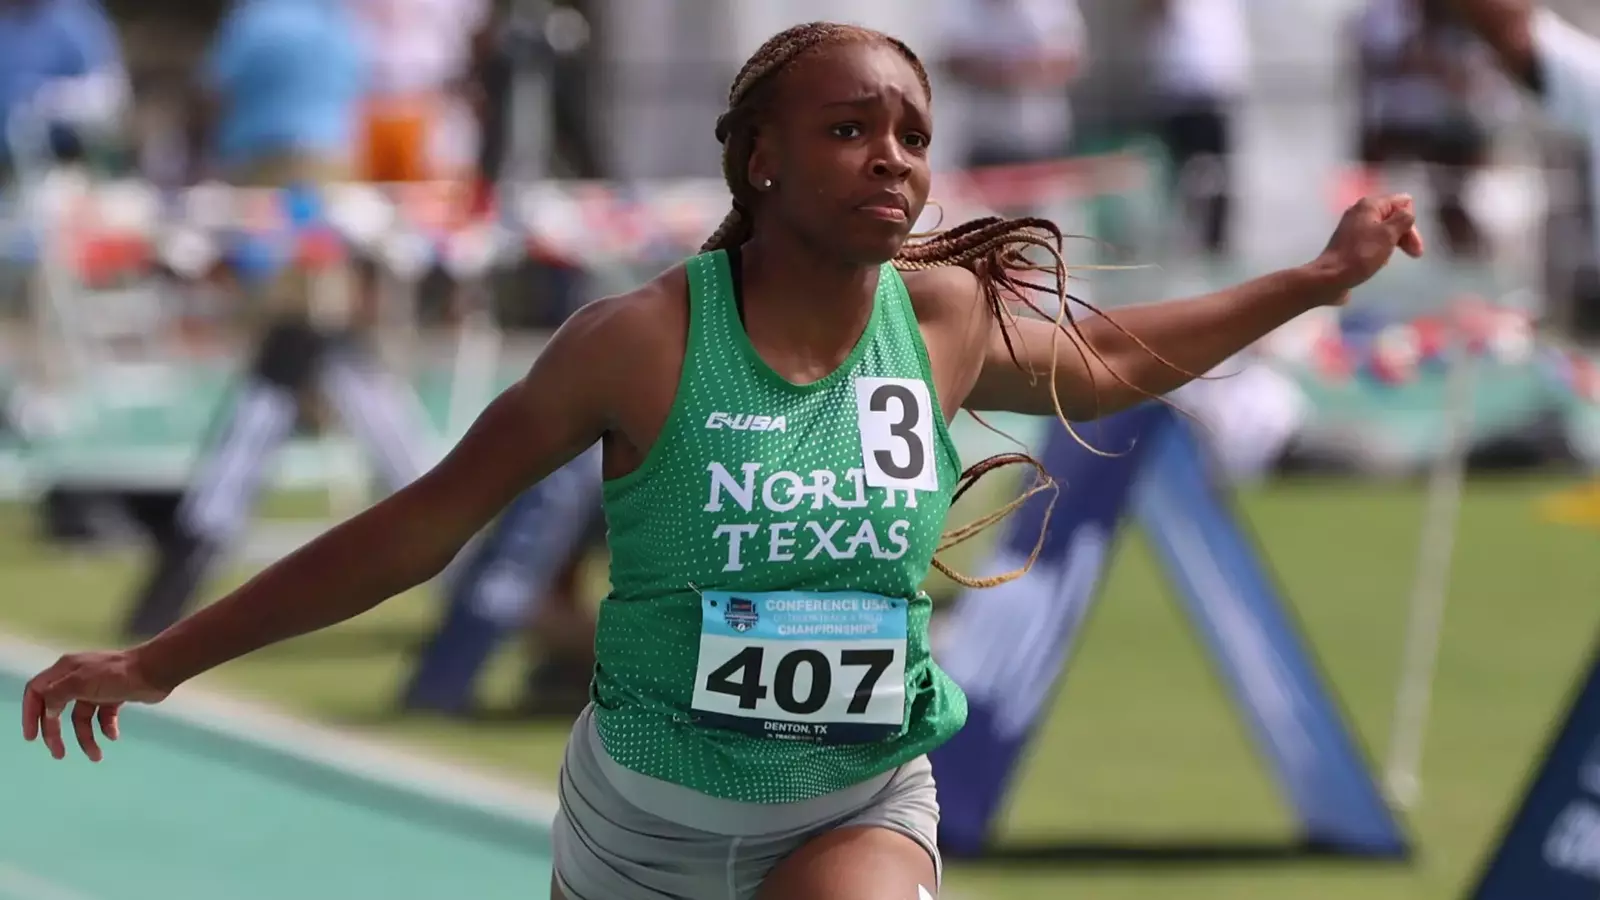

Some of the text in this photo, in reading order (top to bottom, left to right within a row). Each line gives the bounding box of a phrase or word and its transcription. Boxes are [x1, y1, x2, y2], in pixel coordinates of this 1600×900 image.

[870, 384, 925, 480] 3
[712, 519, 911, 572] TEXAS
[765, 599, 859, 612] CONFERENCE
[862, 600, 890, 611] USA
[777, 623, 878, 635] CHAMPIONSHIPS
[706, 646, 894, 715] 407
[813, 725, 828, 734] TX
